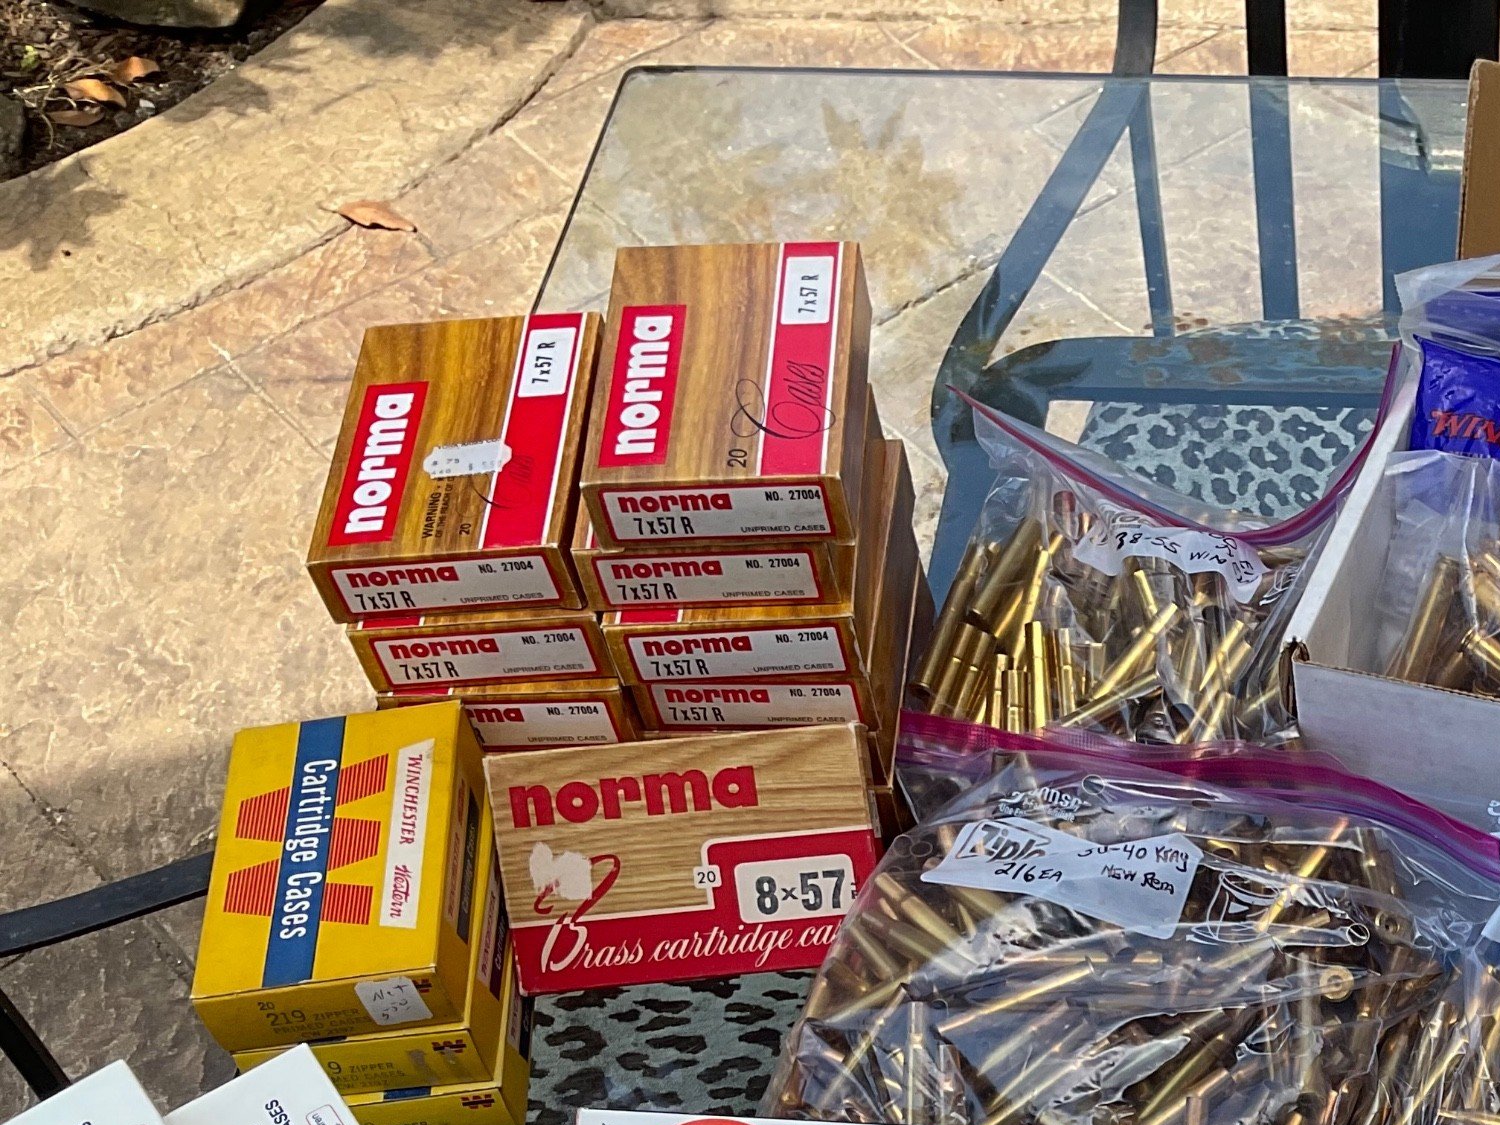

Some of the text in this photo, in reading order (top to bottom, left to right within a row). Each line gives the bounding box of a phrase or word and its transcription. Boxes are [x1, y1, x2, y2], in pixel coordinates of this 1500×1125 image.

[615, 316, 673, 455] norma
[344, 393, 414, 534] norma
[727, 449, 748, 468] 20
[618, 489, 821, 513] norma NO. 27004
[459, 523, 471, 536] 20
[741, 525, 791, 533] UNPRIMED
[347, 560, 533, 588] norma NO. 27004
[388, 635, 500, 662] norma
[509, 765, 759, 829] norma
[280, 759, 337, 939] Cartridge Cases
[390, 754, 423, 919] WINCHESTER Western
[698, 870, 716, 884] 20
[535, 896, 644, 973] Brass
[649, 923, 794, 968] cartridge
[258, 1002, 275, 1011] 20
[266, 1011, 306, 1026] 219
